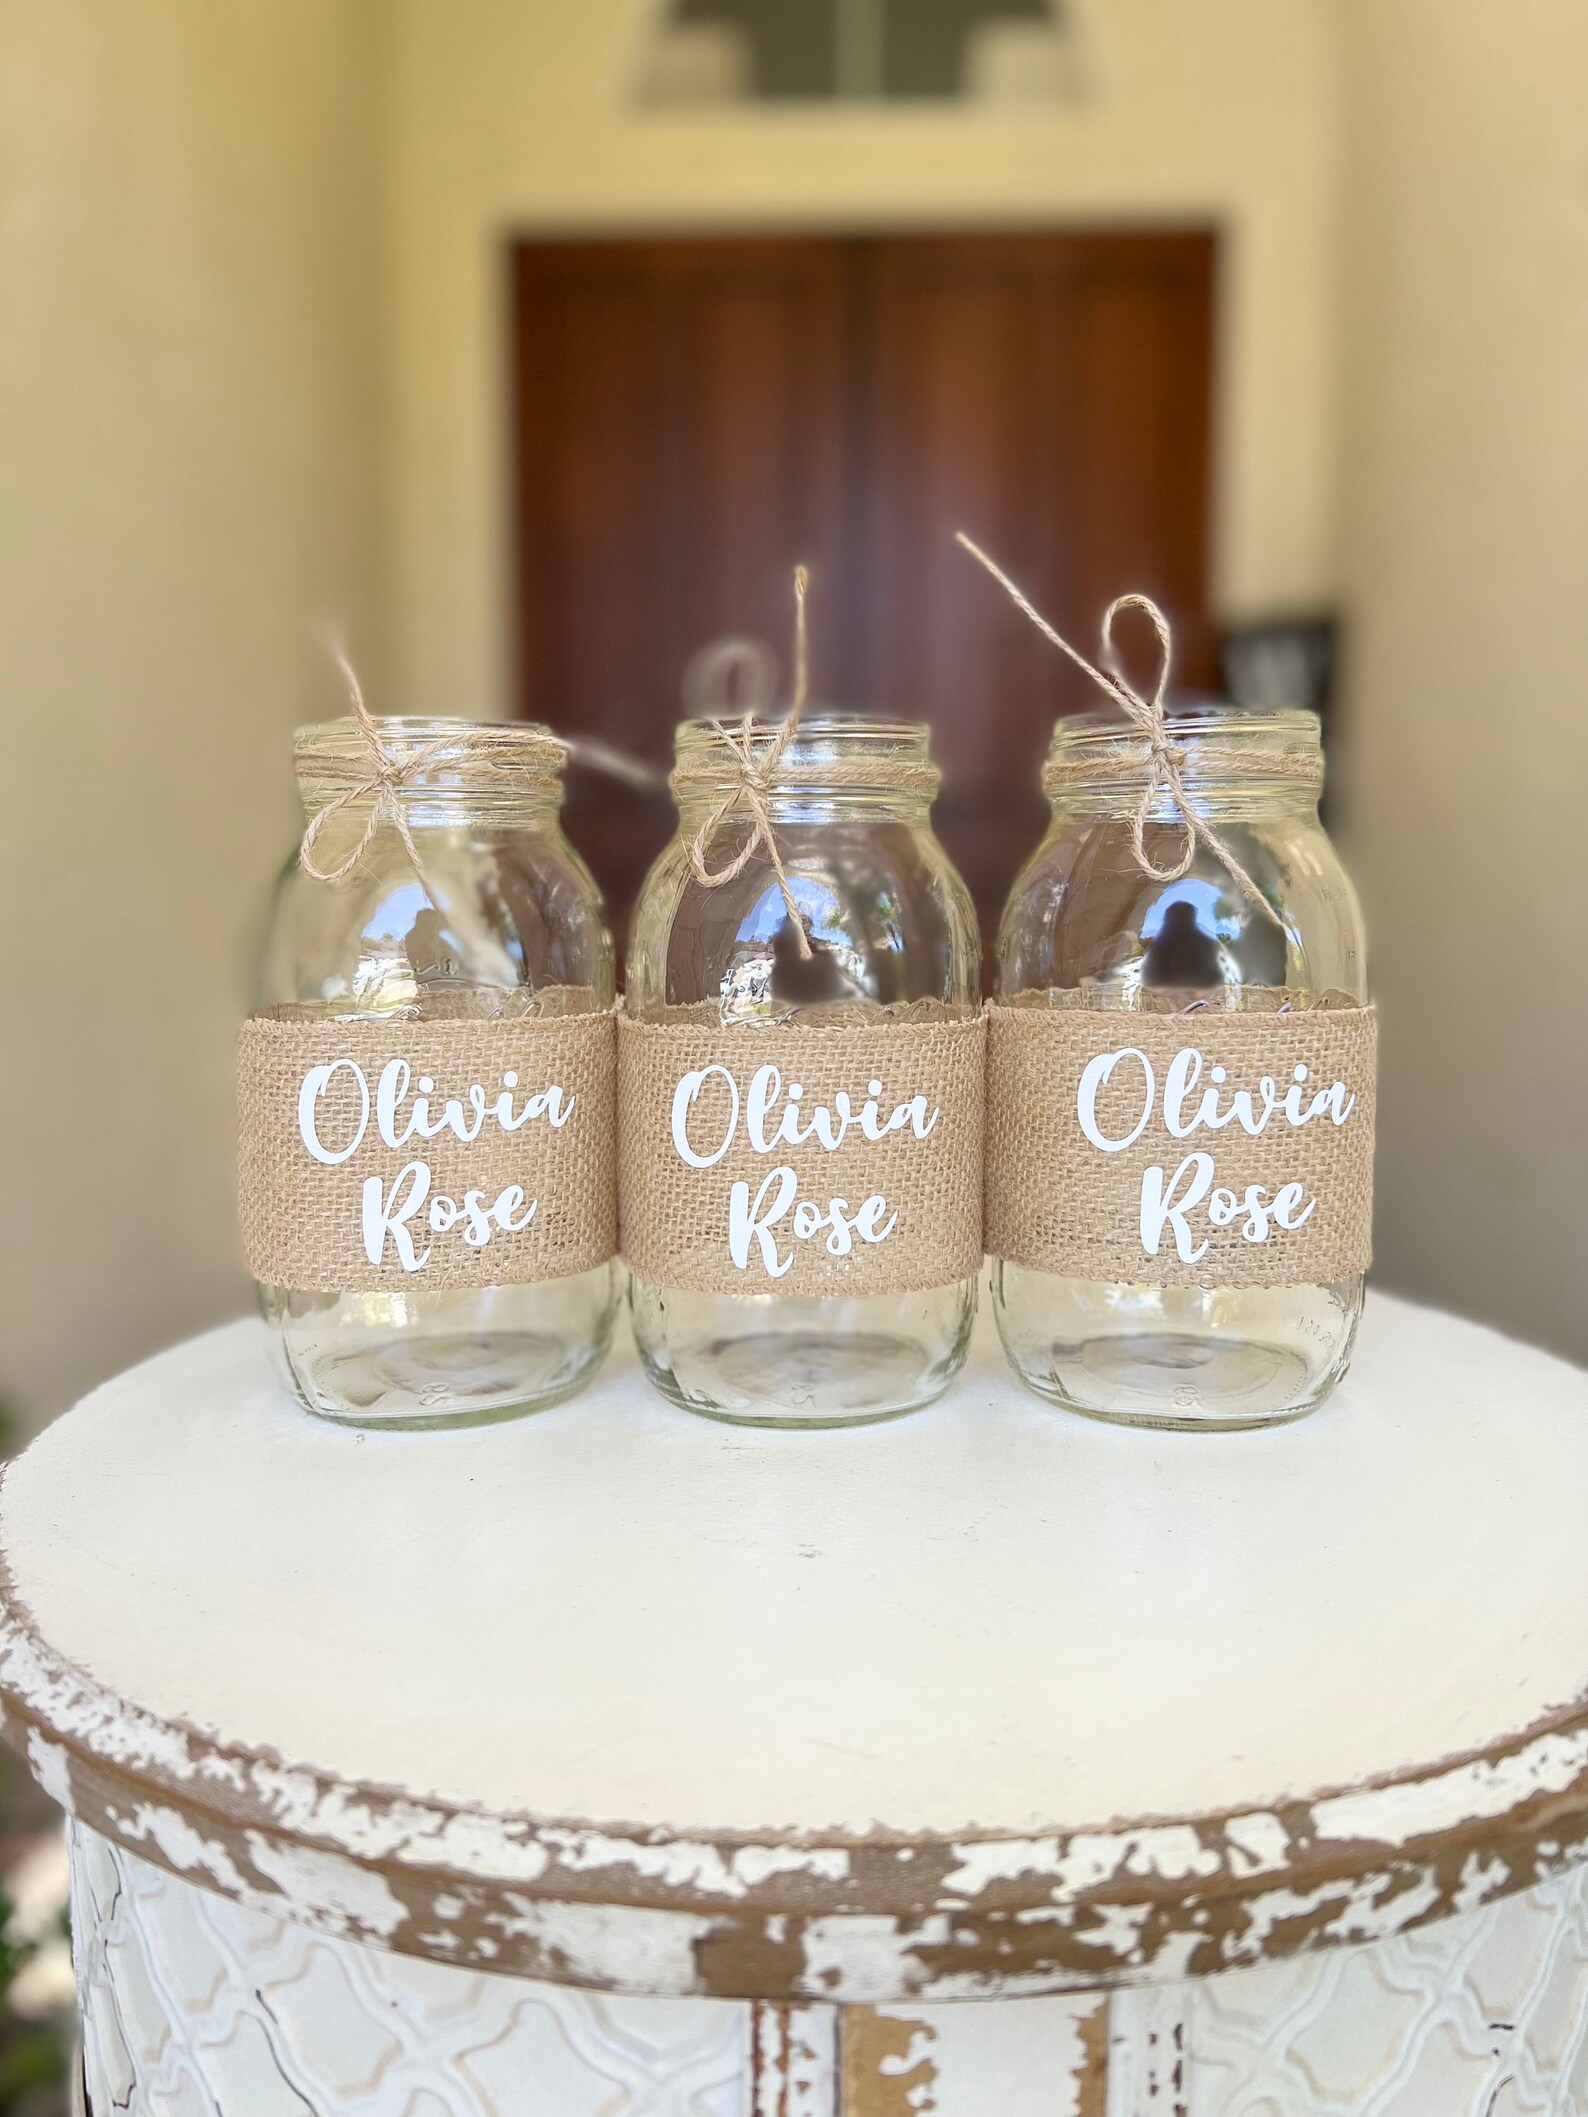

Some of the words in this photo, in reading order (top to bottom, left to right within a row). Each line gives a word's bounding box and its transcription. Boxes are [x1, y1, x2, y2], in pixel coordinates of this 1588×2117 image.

[298, 1058, 575, 1165] Olivia
[671, 1064, 940, 1169] Olivia
[1076, 1047, 1356, 1152] Olivia
[362, 1161, 538, 1272] Rose
[728, 1166, 899, 1279] Rose
[1139, 1152, 1317, 1265] Rose
